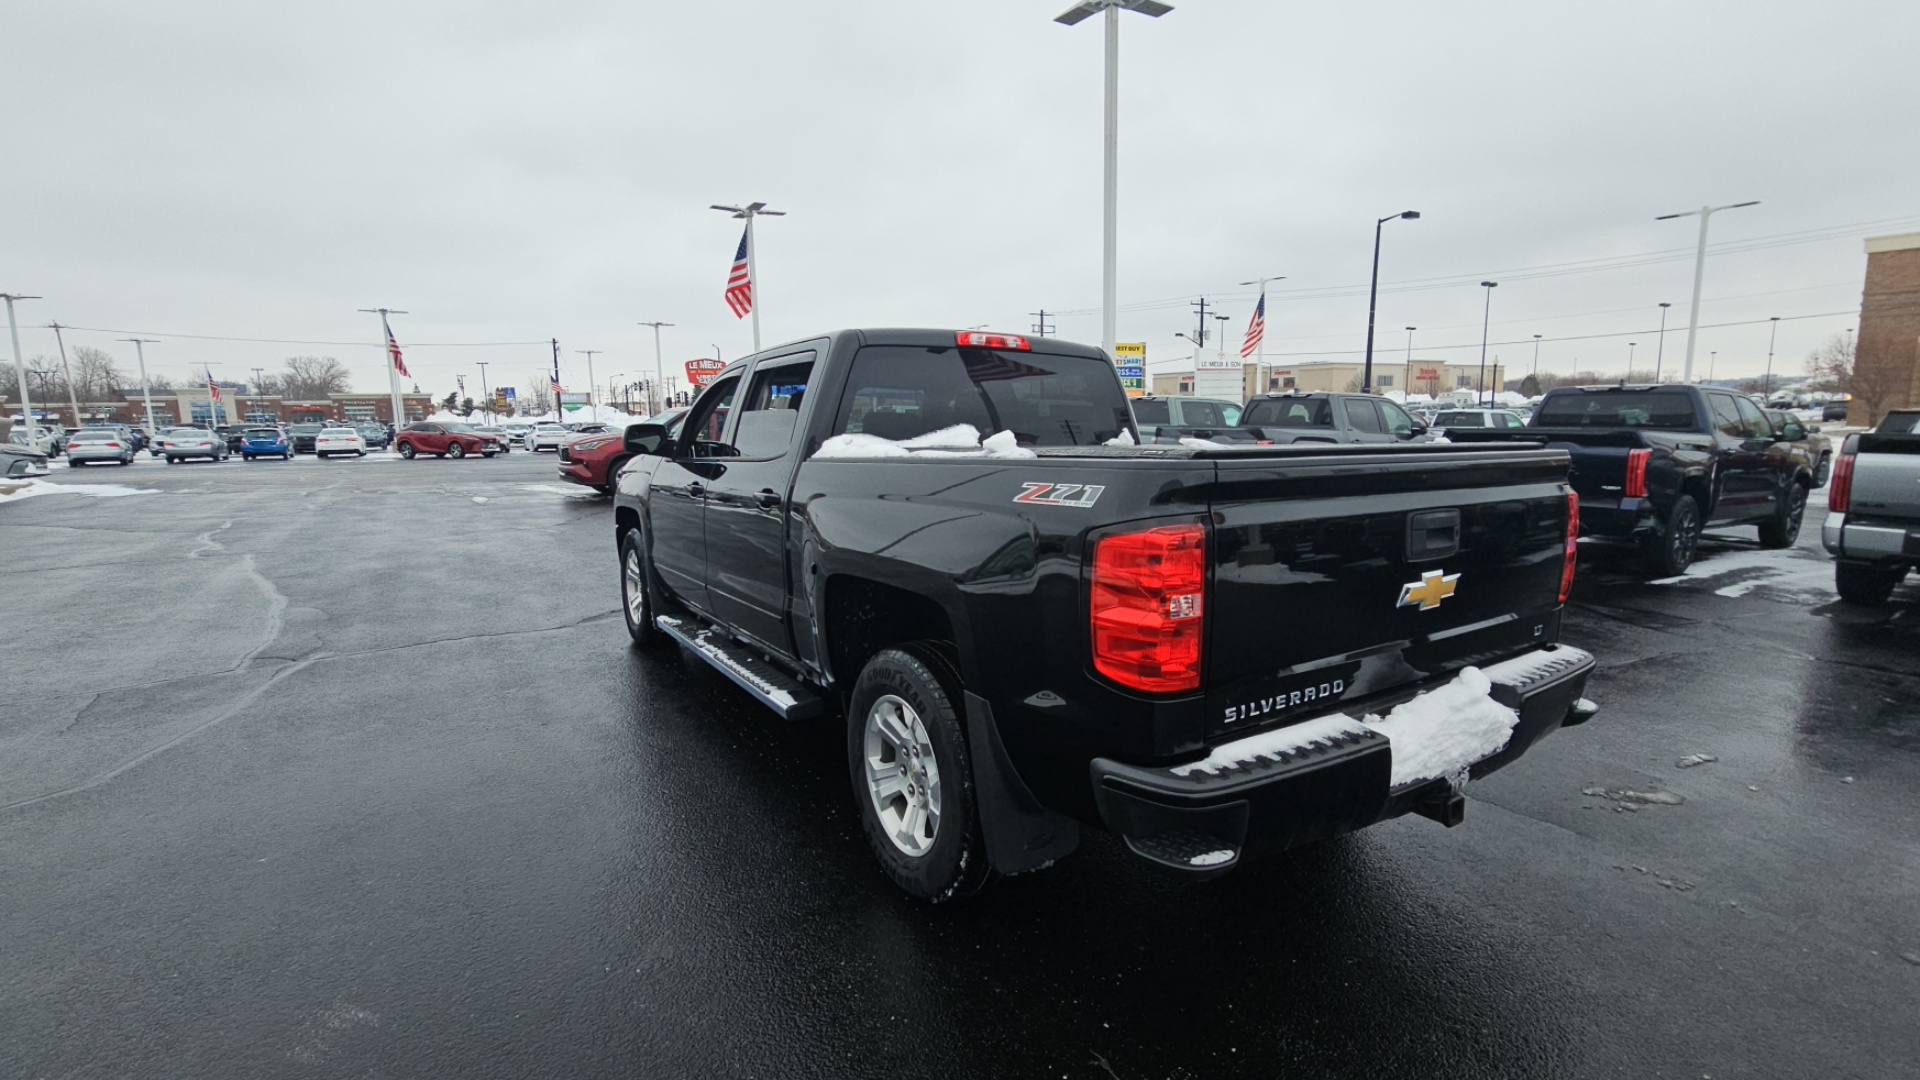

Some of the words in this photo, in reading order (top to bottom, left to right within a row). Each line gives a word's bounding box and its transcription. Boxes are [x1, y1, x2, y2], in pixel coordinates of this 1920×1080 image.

[699, 360, 722, 369] MIEUX
[1012, 482, 1105, 507] Z71
[1534, 625, 1543, 636] LT
[1224, 680, 1344, 723] SILVERADO
